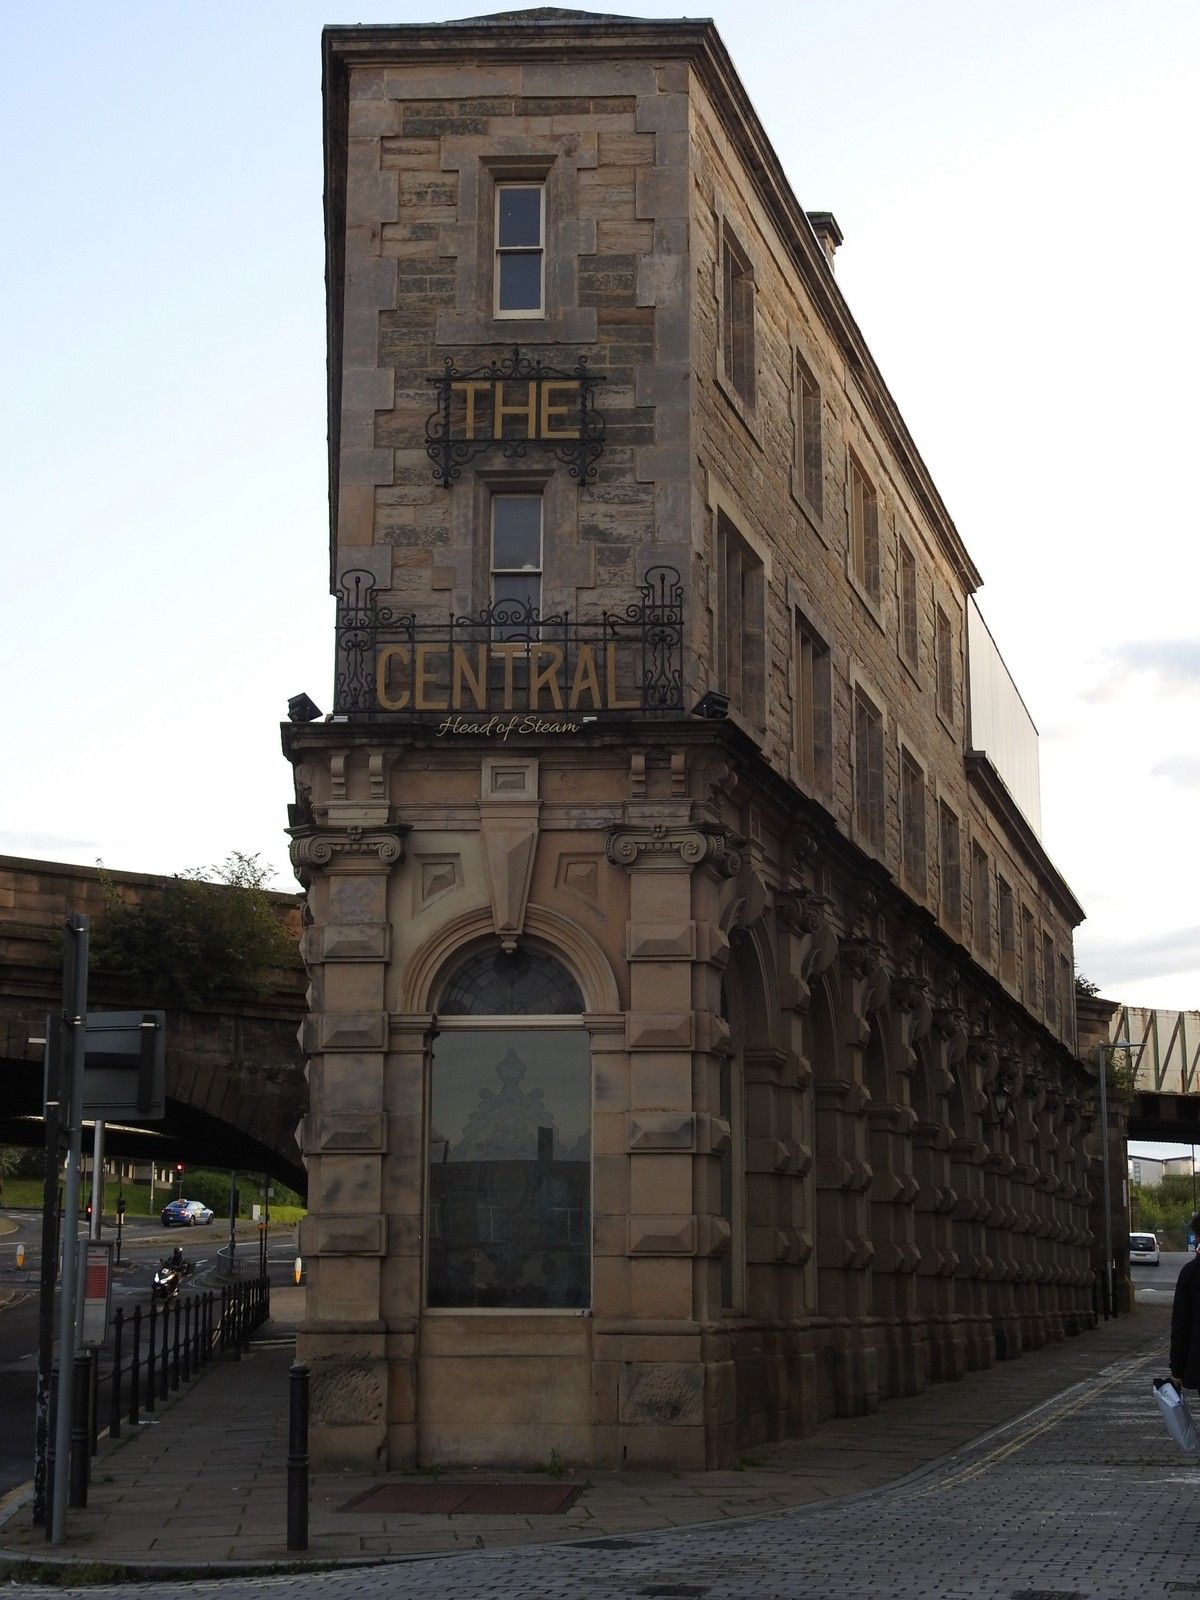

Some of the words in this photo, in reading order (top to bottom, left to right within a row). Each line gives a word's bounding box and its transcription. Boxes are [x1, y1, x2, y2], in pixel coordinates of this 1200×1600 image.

[451, 381, 580, 440] THE
[376, 642, 641, 711] CENTRAL
[436, 716, 498, 736] Head
[496, 716, 516, 741] of
[518, 716, 580, 734] Steam
